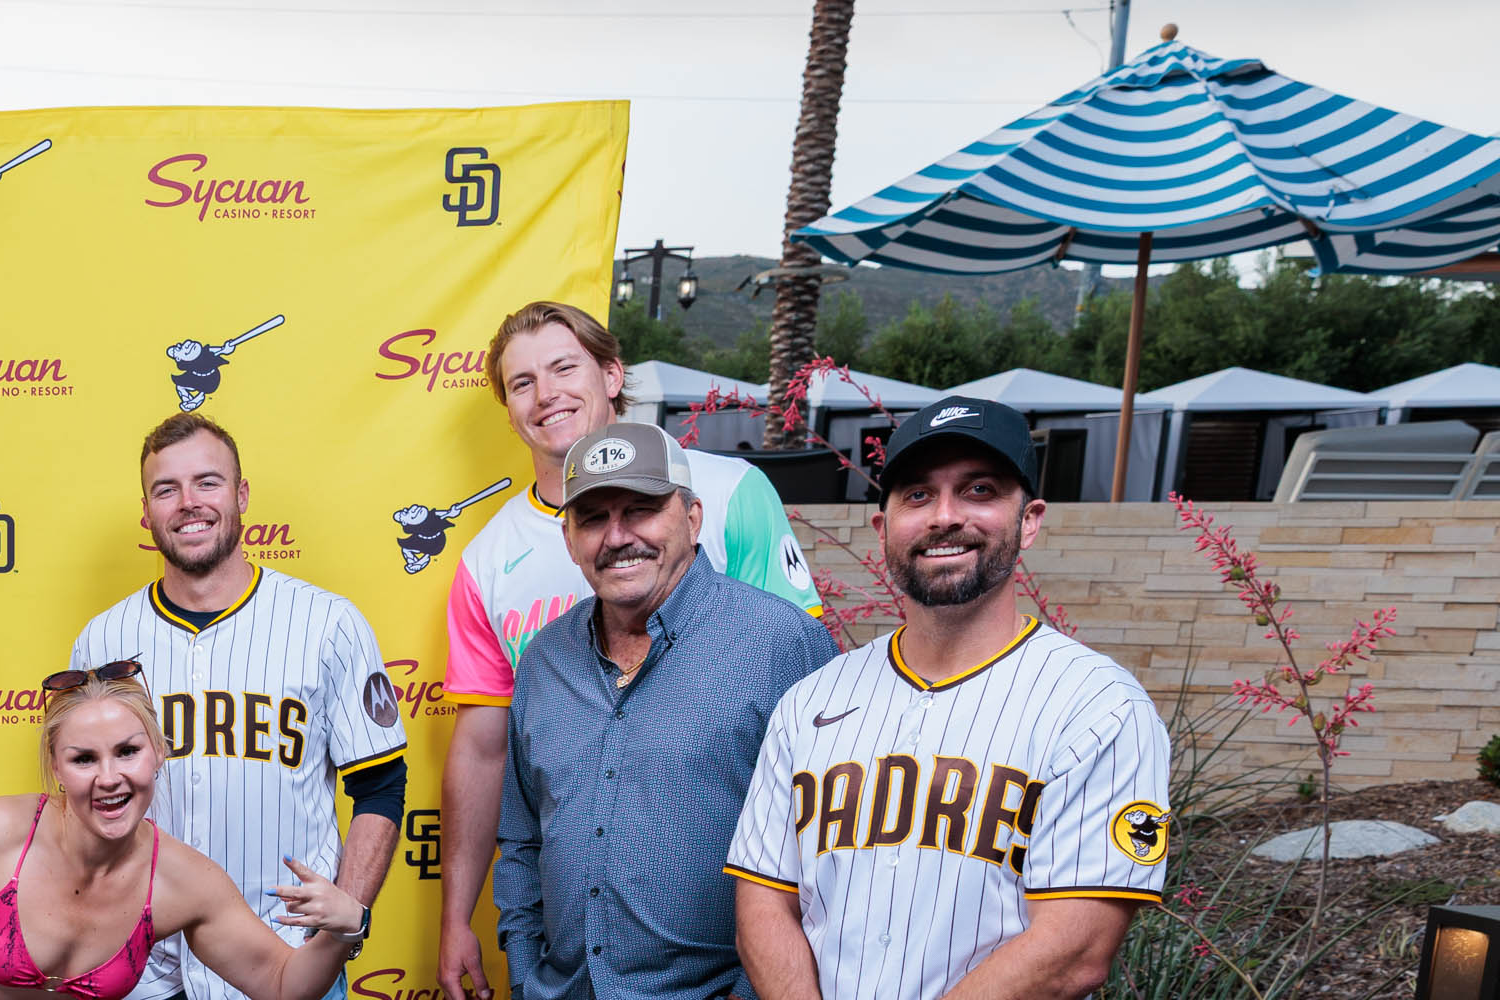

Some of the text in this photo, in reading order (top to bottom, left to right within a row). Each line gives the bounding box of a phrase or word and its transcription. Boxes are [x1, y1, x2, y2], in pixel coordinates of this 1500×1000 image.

[145, 153, 310, 222] Sycuan
[442, 147, 500, 227] SD
[214, 208, 316, 219] CASINO RESORT
[375, 328, 486, 392] Sycu
[442, 378, 489, 389] CASINO
[31, 386, 74, 396] RESORT
[936, 406, 969, 419] NIKE
[598, 447, 626, 465] 1%
[259, 550, 301, 560] RESORT
[425, 706, 458, 716] CASIN
[160, 690, 308, 769] DRES
